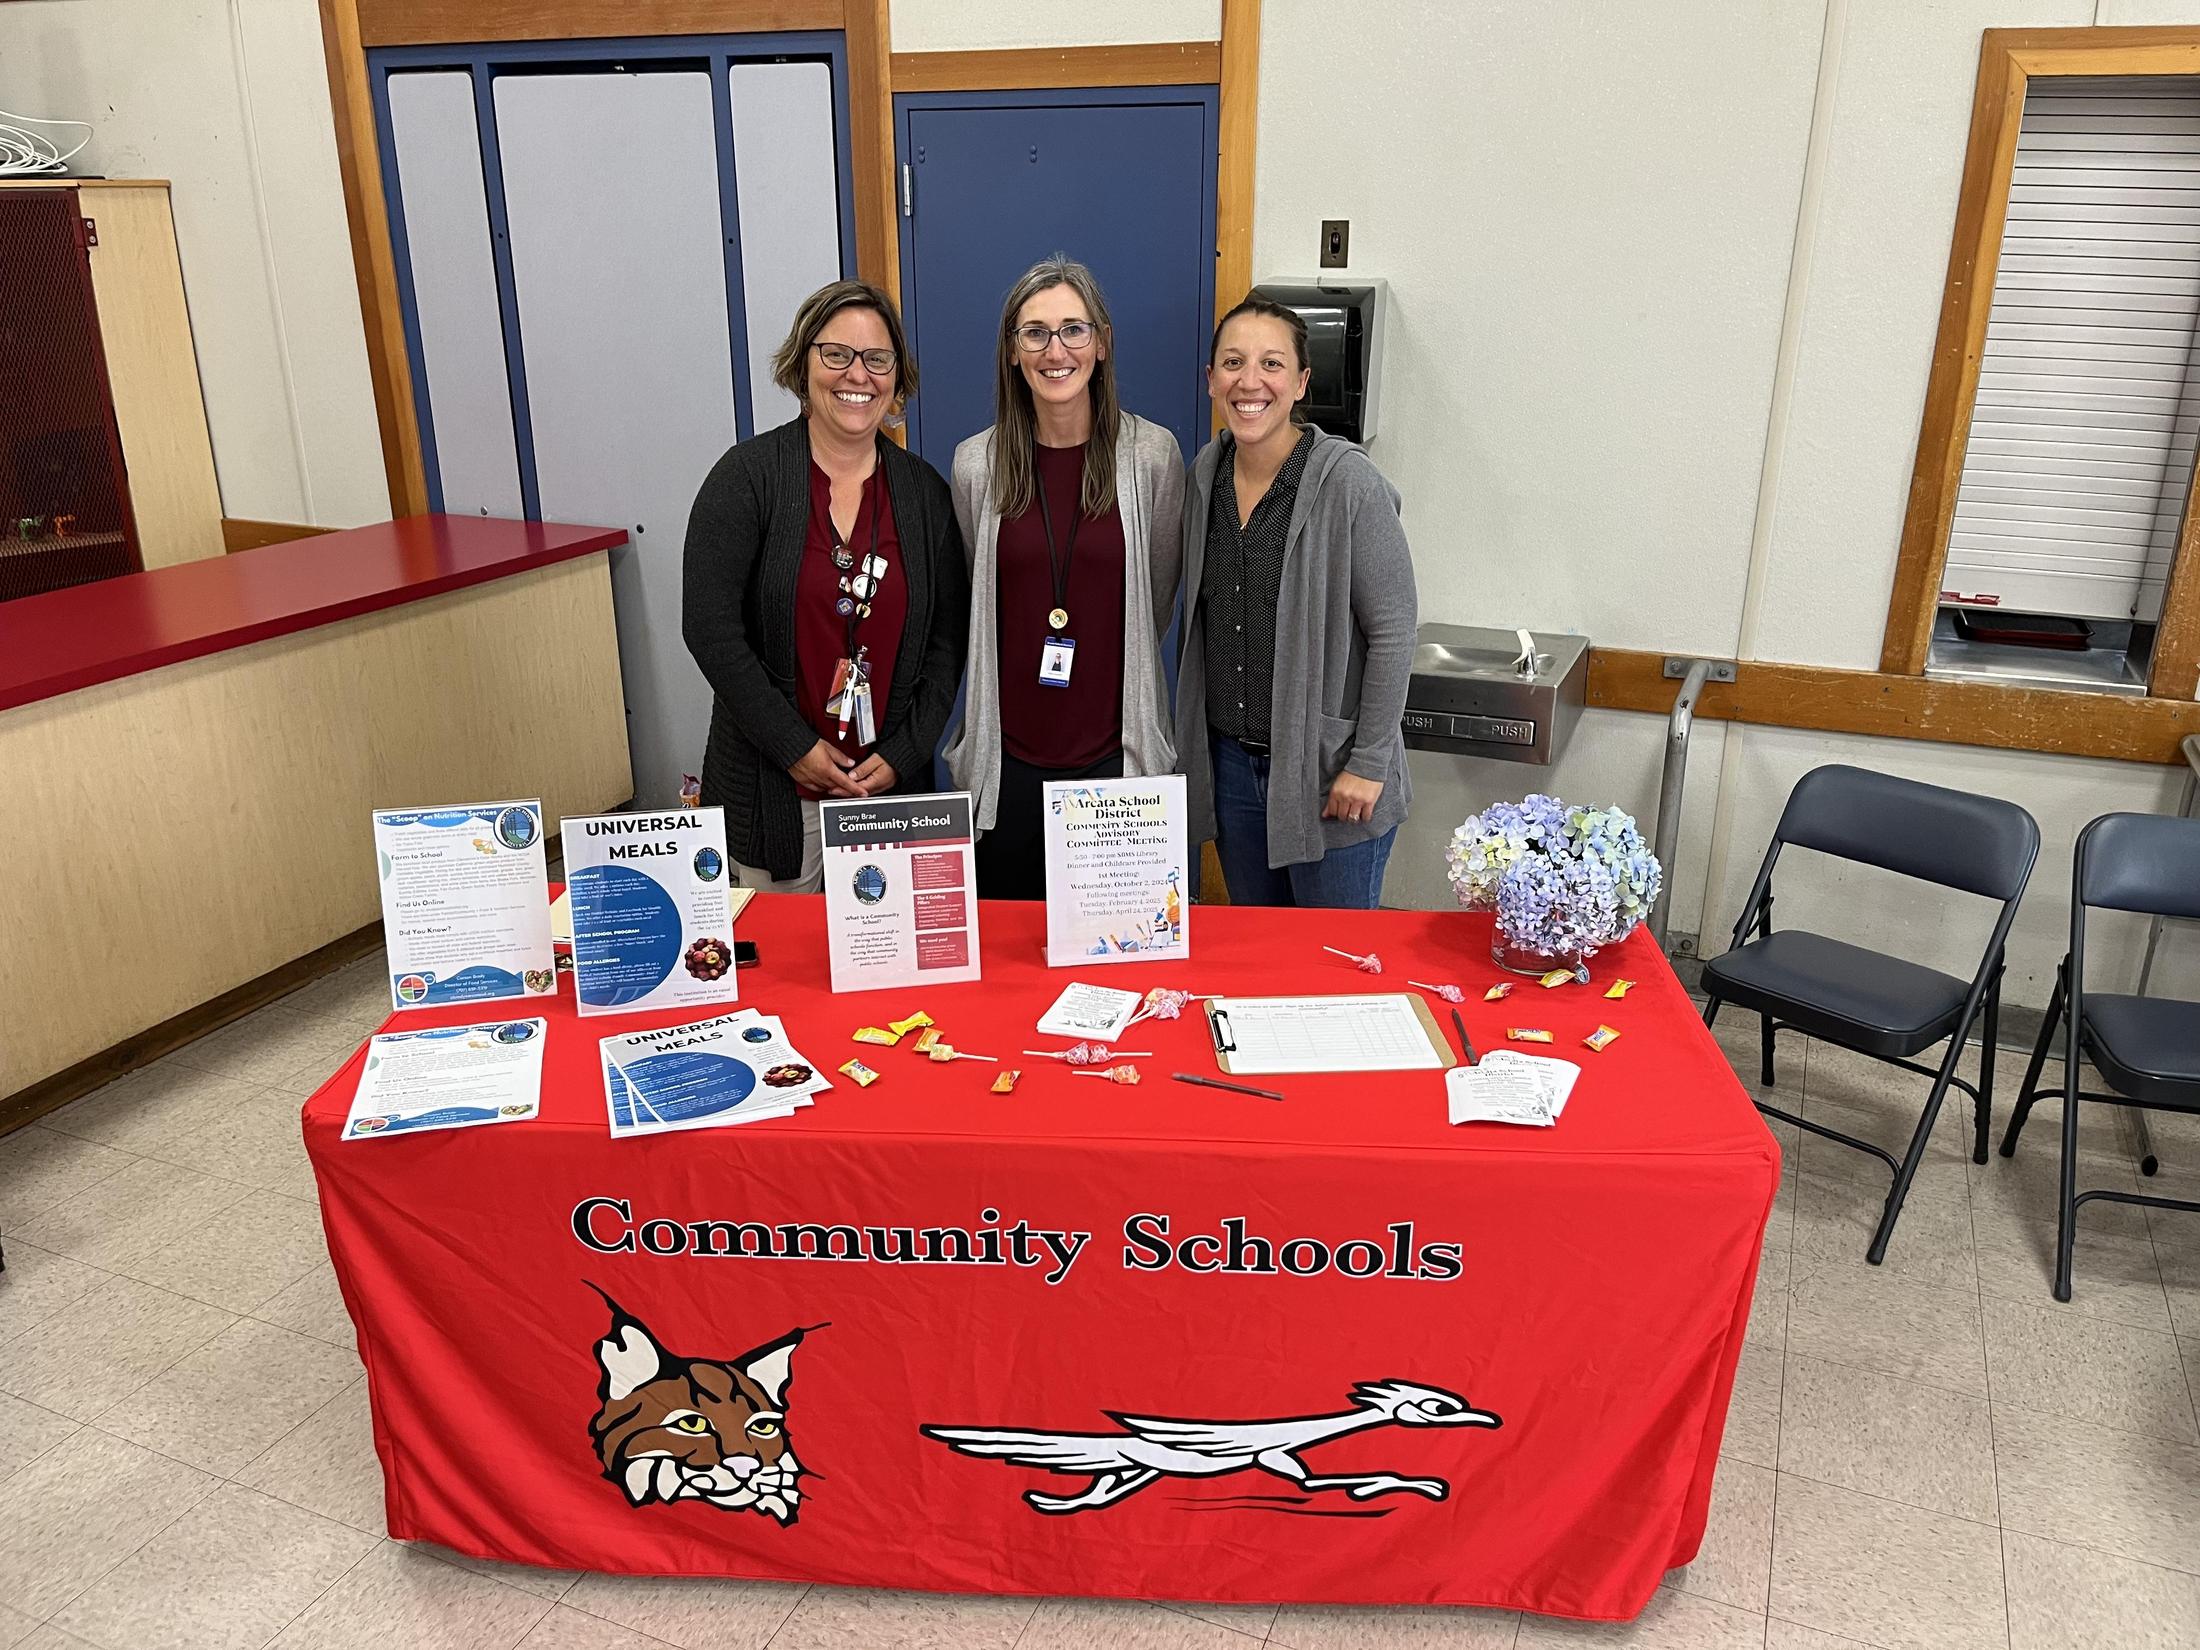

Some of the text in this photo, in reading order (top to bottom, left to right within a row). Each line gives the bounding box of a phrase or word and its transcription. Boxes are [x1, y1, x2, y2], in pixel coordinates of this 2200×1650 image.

[1401, 715, 1433, 729] PUSH
[1492, 726, 1528, 740] PUSH
[1076, 795, 1160, 809] Arcata School
[377, 816, 391, 824] The
[839, 814, 860, 823] Sunny
[1095, 808, 1141, 819] District
[586, 816, 702, 836] UNIVERSAL
[839, 814, 951, 833] Community School
[1124, 820, 1168, 829] SCHOOLS
[609, 842, 678, 860] MEALS
[627, 1016, 740, 1046] UNIVERSAL
[655, 1032, 723, 1052] MEALS
[570, 1196, 1464, 1286] Community Schools
